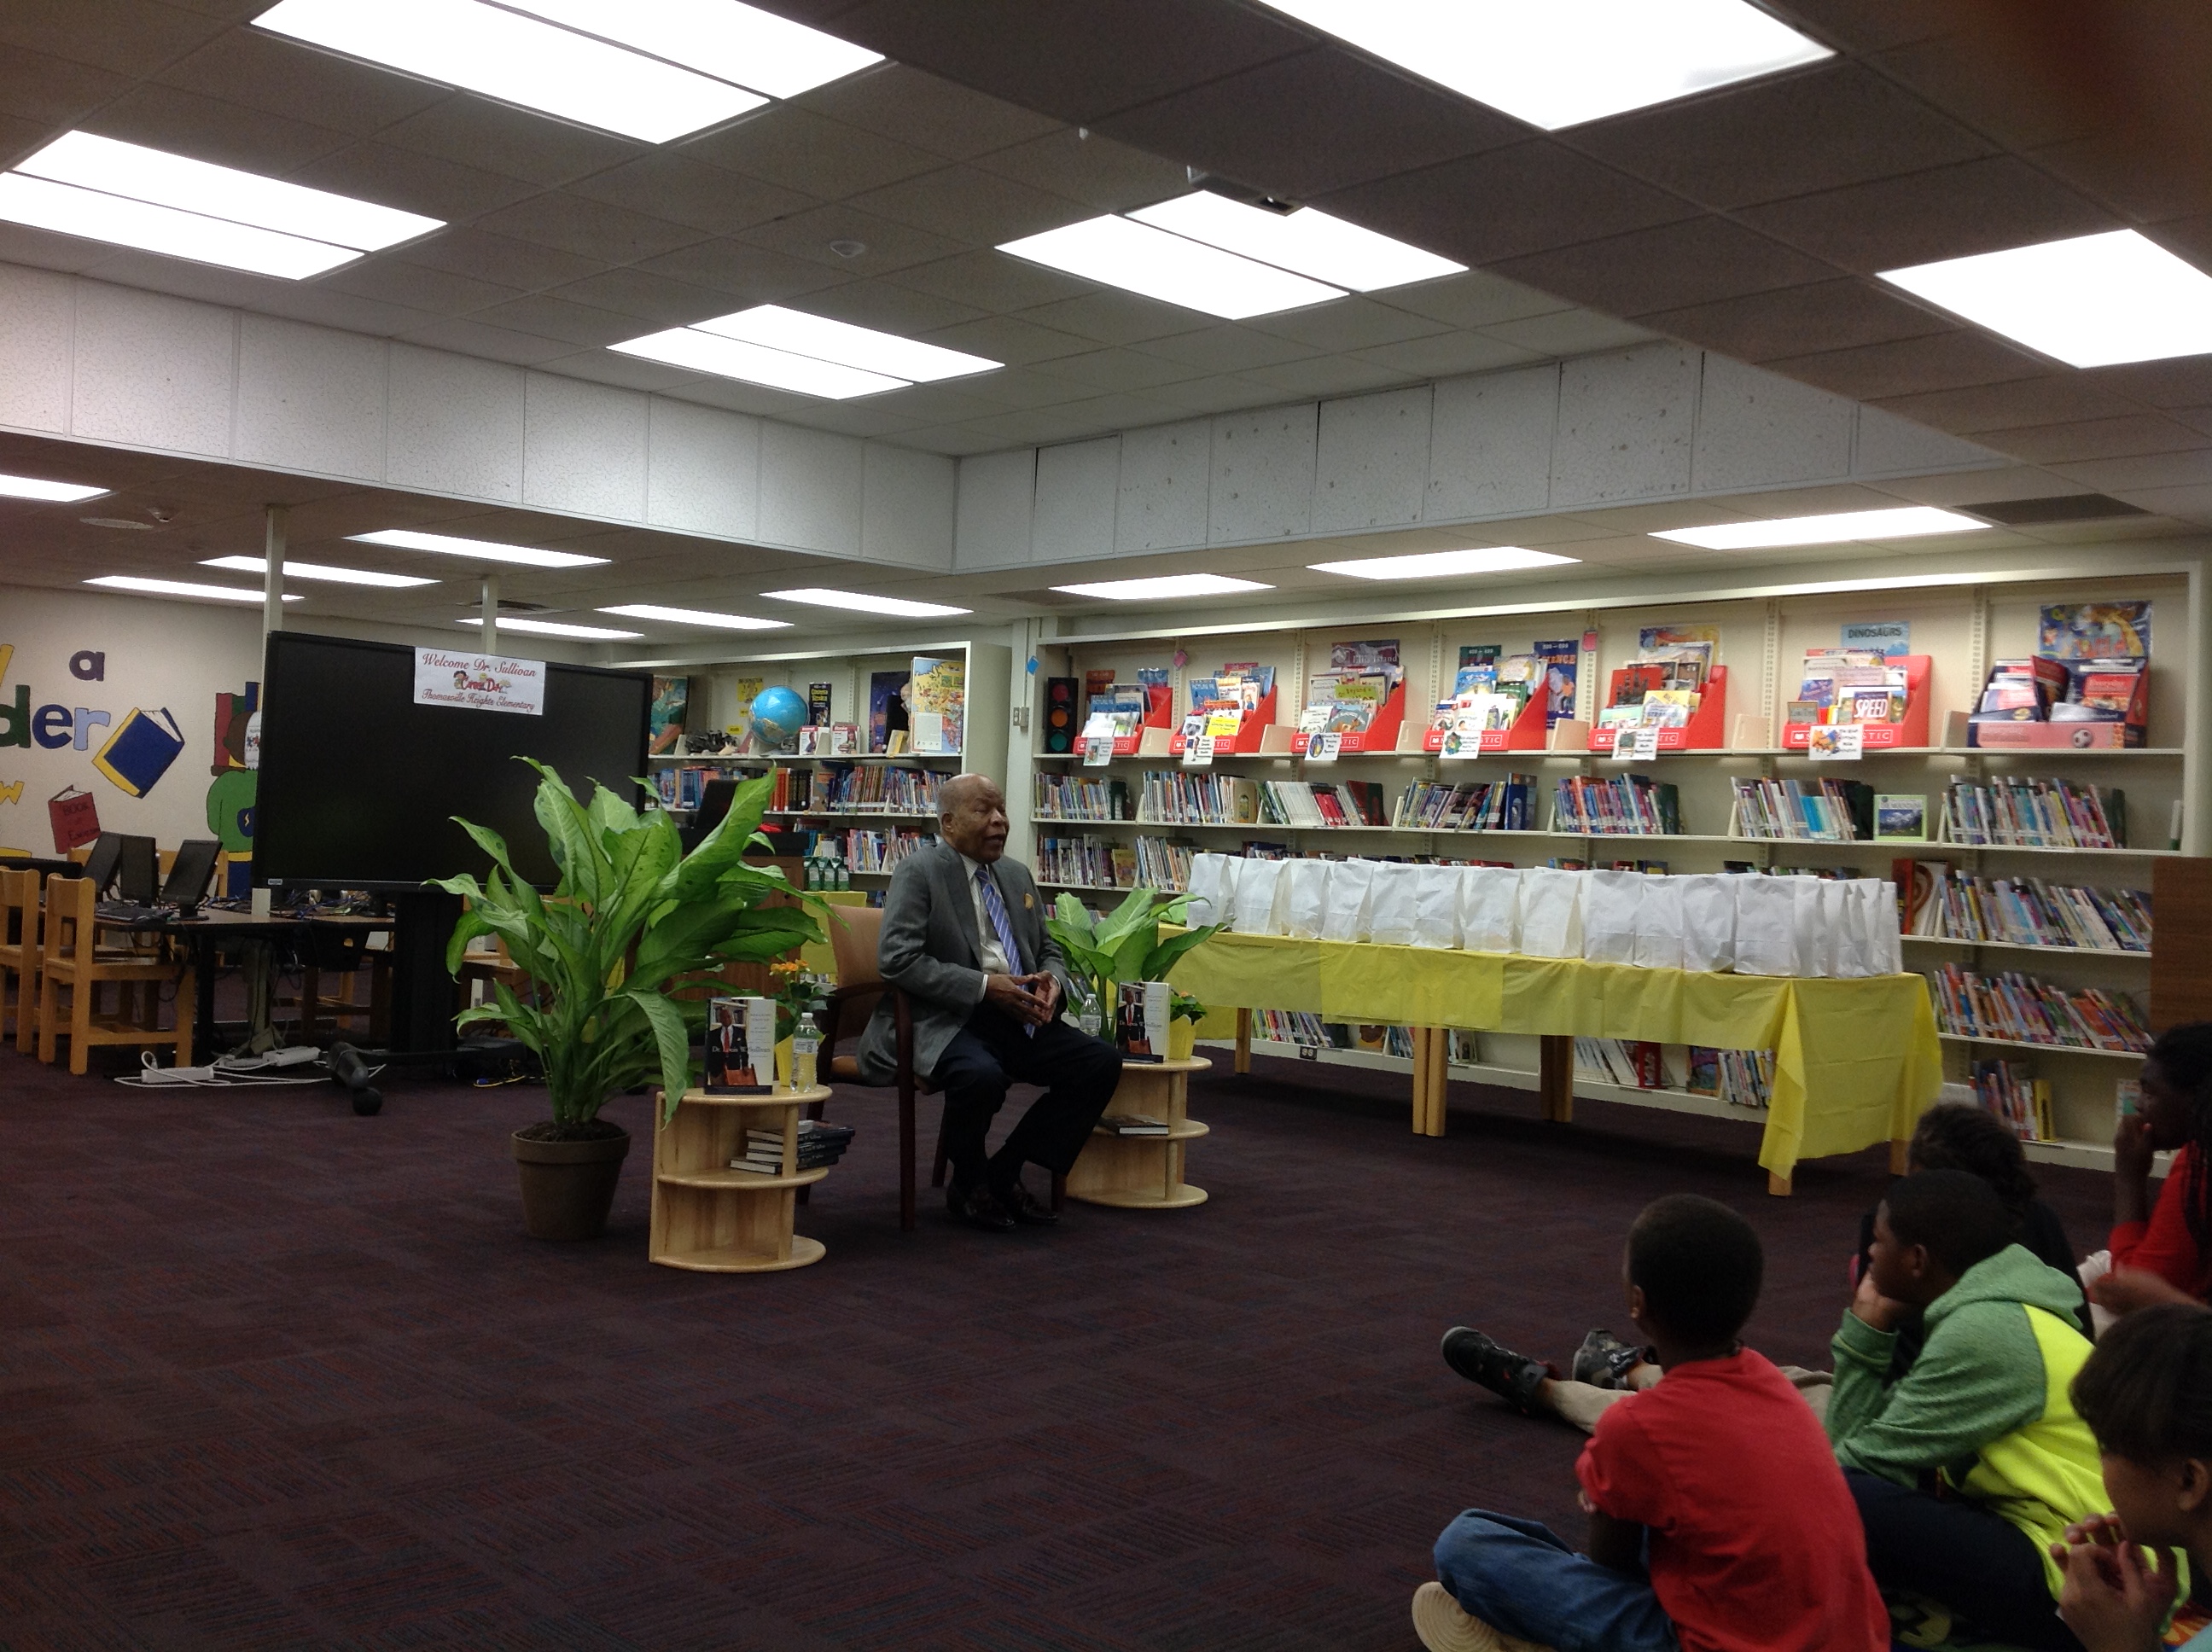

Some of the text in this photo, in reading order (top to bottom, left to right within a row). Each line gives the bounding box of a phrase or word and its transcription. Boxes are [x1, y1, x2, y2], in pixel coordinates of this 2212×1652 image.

[1848, 627, 1901, 638] DINOSAURS
[69, 650, 105, 682] a
[422, 653, 537, 677] Welcome Dr. Sullivan
[1373, 654, 1397, 663] Island
[422, 689, 535, 713] Thomasville Heights Elementary
[1854, 699, 1888, 718] SPEED
